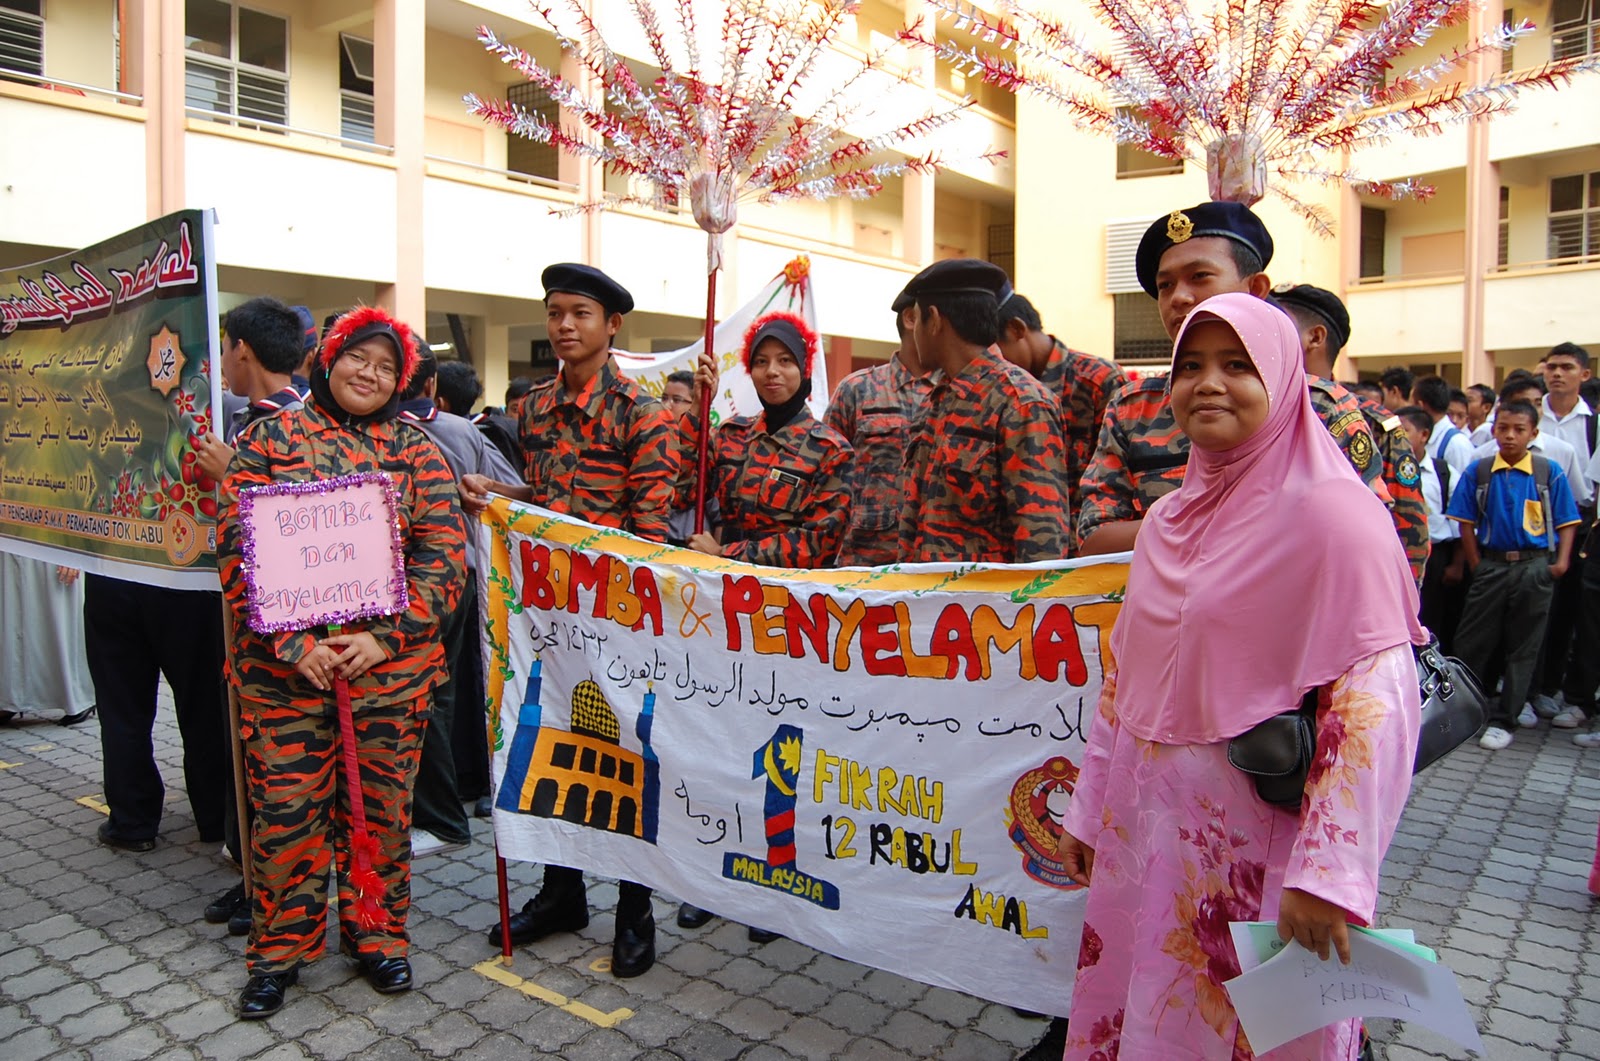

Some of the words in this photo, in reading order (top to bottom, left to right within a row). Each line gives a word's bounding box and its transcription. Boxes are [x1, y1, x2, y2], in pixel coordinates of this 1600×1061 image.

[66, 514, 110, 537] PERMATANG
[112, 521, 131, 540] TOK
[134, 524, 163, 544] LABU
[519, 540, 664, 637] BOMBA
[679, 582, 713, 638] &
[721, 573, 1123, 687] PENYELAMAT
[812, 748, 944, 824] FIKRAH
[821, 815, 858, 860] 12
[732, 857, 824, 902] MALAYSIA
[954, 883, 1049, 939] AWAL
